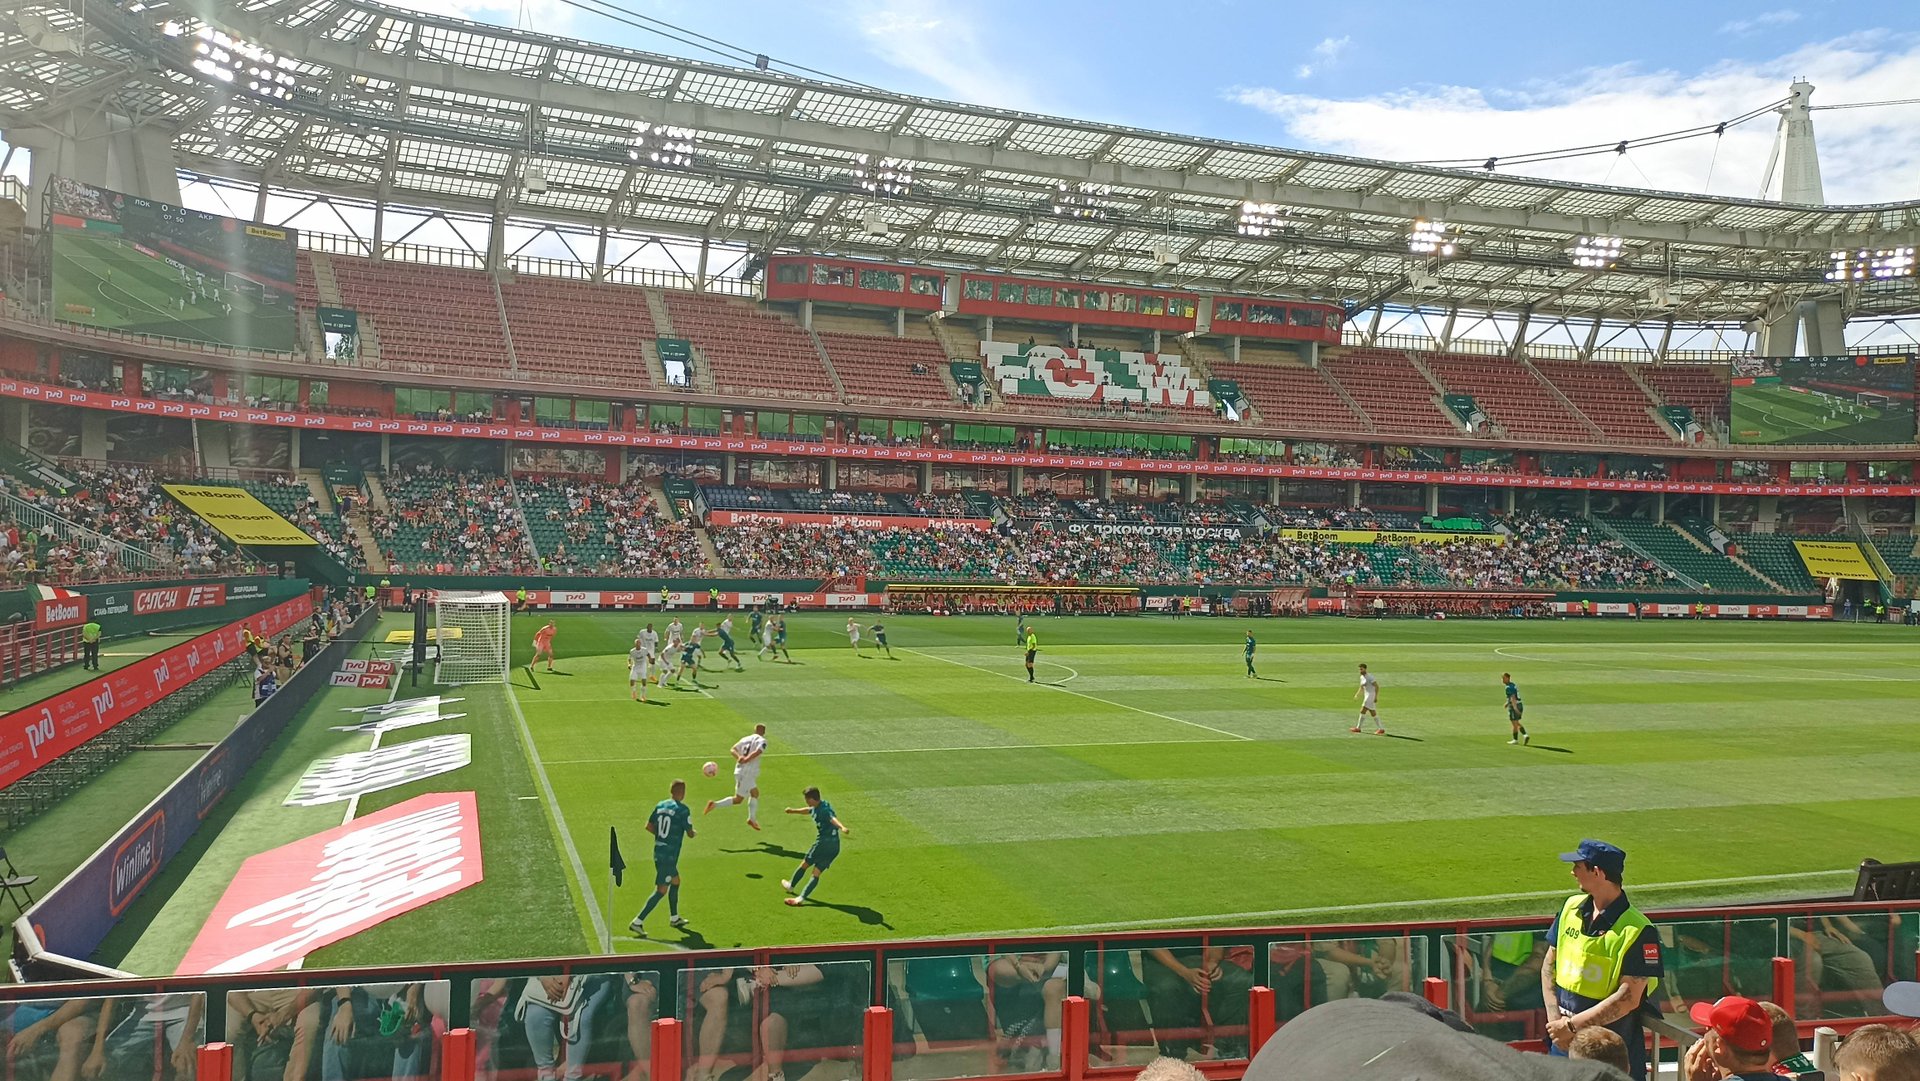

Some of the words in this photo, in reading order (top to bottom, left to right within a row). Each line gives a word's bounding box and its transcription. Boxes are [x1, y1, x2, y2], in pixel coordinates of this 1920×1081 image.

[177, 489, 245, 499] BetBoom
[205, 512, 274, 520] BetBoom
[1068, 524, 1089, 533] ФК
[1297, 531, 1338, 541] BetBoom
[45, 603, 79, 623] BetBoom
[657, 814, 671, 839] 10
[116, 841, 151, 896] Winline
[1565, 926, 1580, 940] 409
